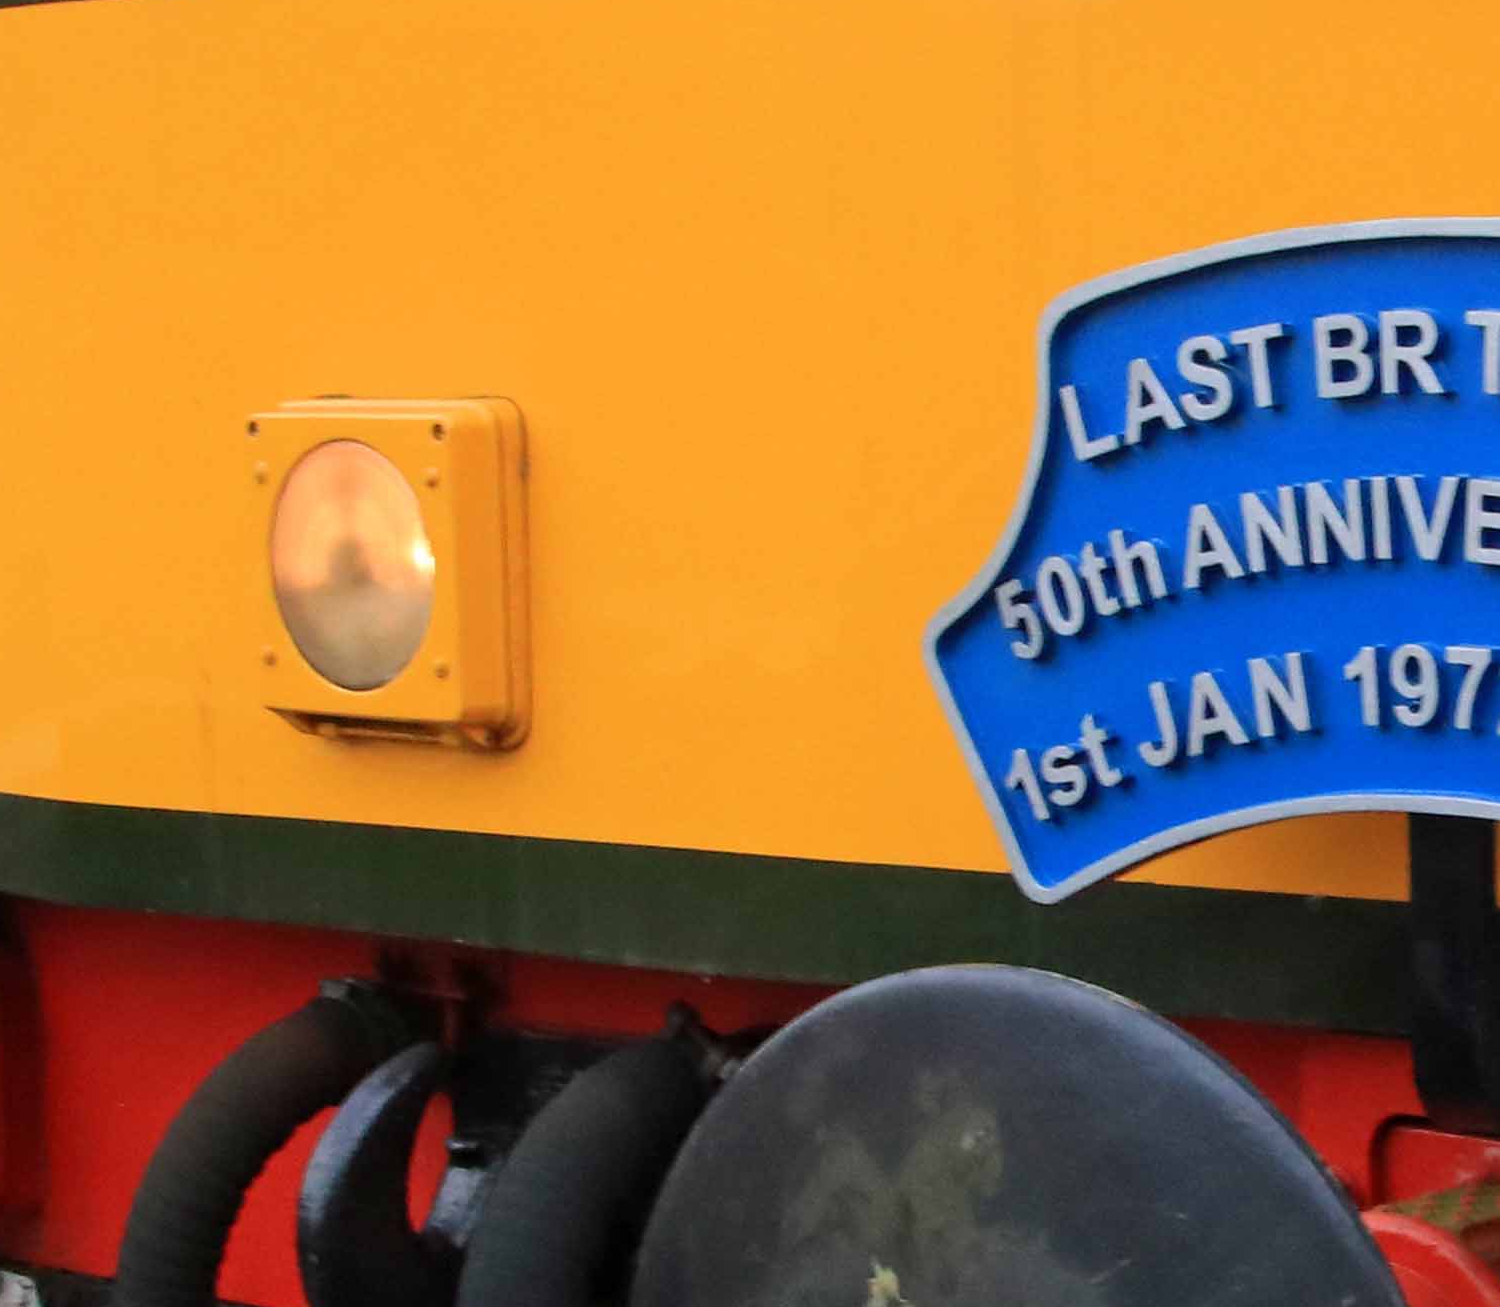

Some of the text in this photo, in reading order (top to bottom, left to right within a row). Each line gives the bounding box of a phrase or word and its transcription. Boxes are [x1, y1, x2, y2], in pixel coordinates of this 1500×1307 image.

[1059, 322, 1284, 462] LAST
[1312, 309, 1449, 400] BR
[995, 529, 1168, 661] 50th
[1004, 713, 1123, 822] 1st
[1137, 651, 1312, 768] JAN
